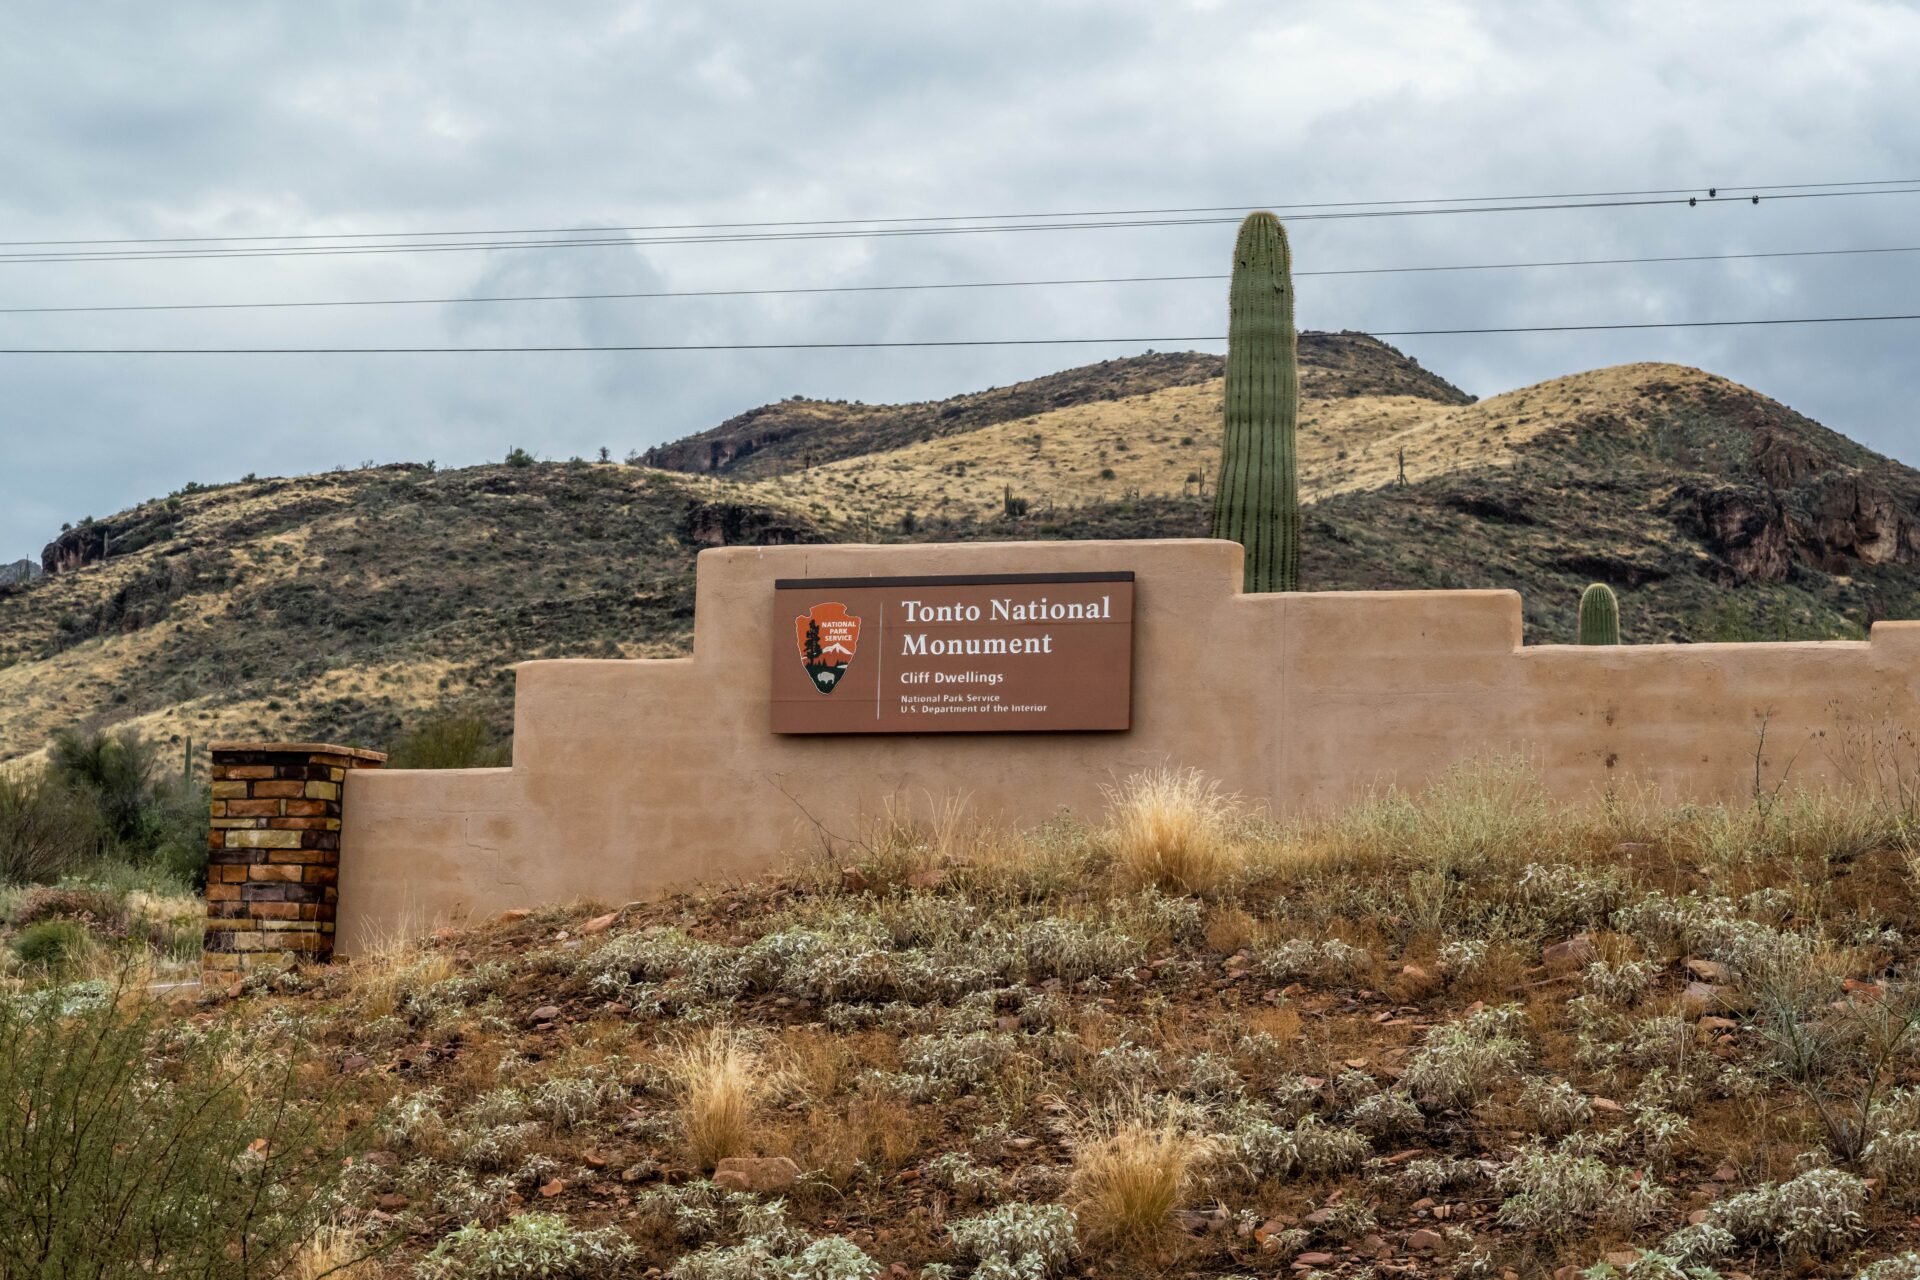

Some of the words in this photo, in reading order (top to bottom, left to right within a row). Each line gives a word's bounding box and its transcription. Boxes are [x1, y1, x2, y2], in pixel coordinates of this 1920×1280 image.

[901, 600, 981, 622] Tonto
[989, 596, 1111, 621] National
[901, 634, 1053, 656] Monument
[900, 671, 930, 684] Cliff
[934, 671, 1004, 686] Dwellings
[900, 694, 941, 703] National
[943, 694, 964, 703] Park
[966, 694, 1001, 702] Service
[921, 704, 978, 715] Department
[980, 704, 991, 713] of
[993, 704, 1009, 713] the
[1011, 704, 1048, 713] Interior
